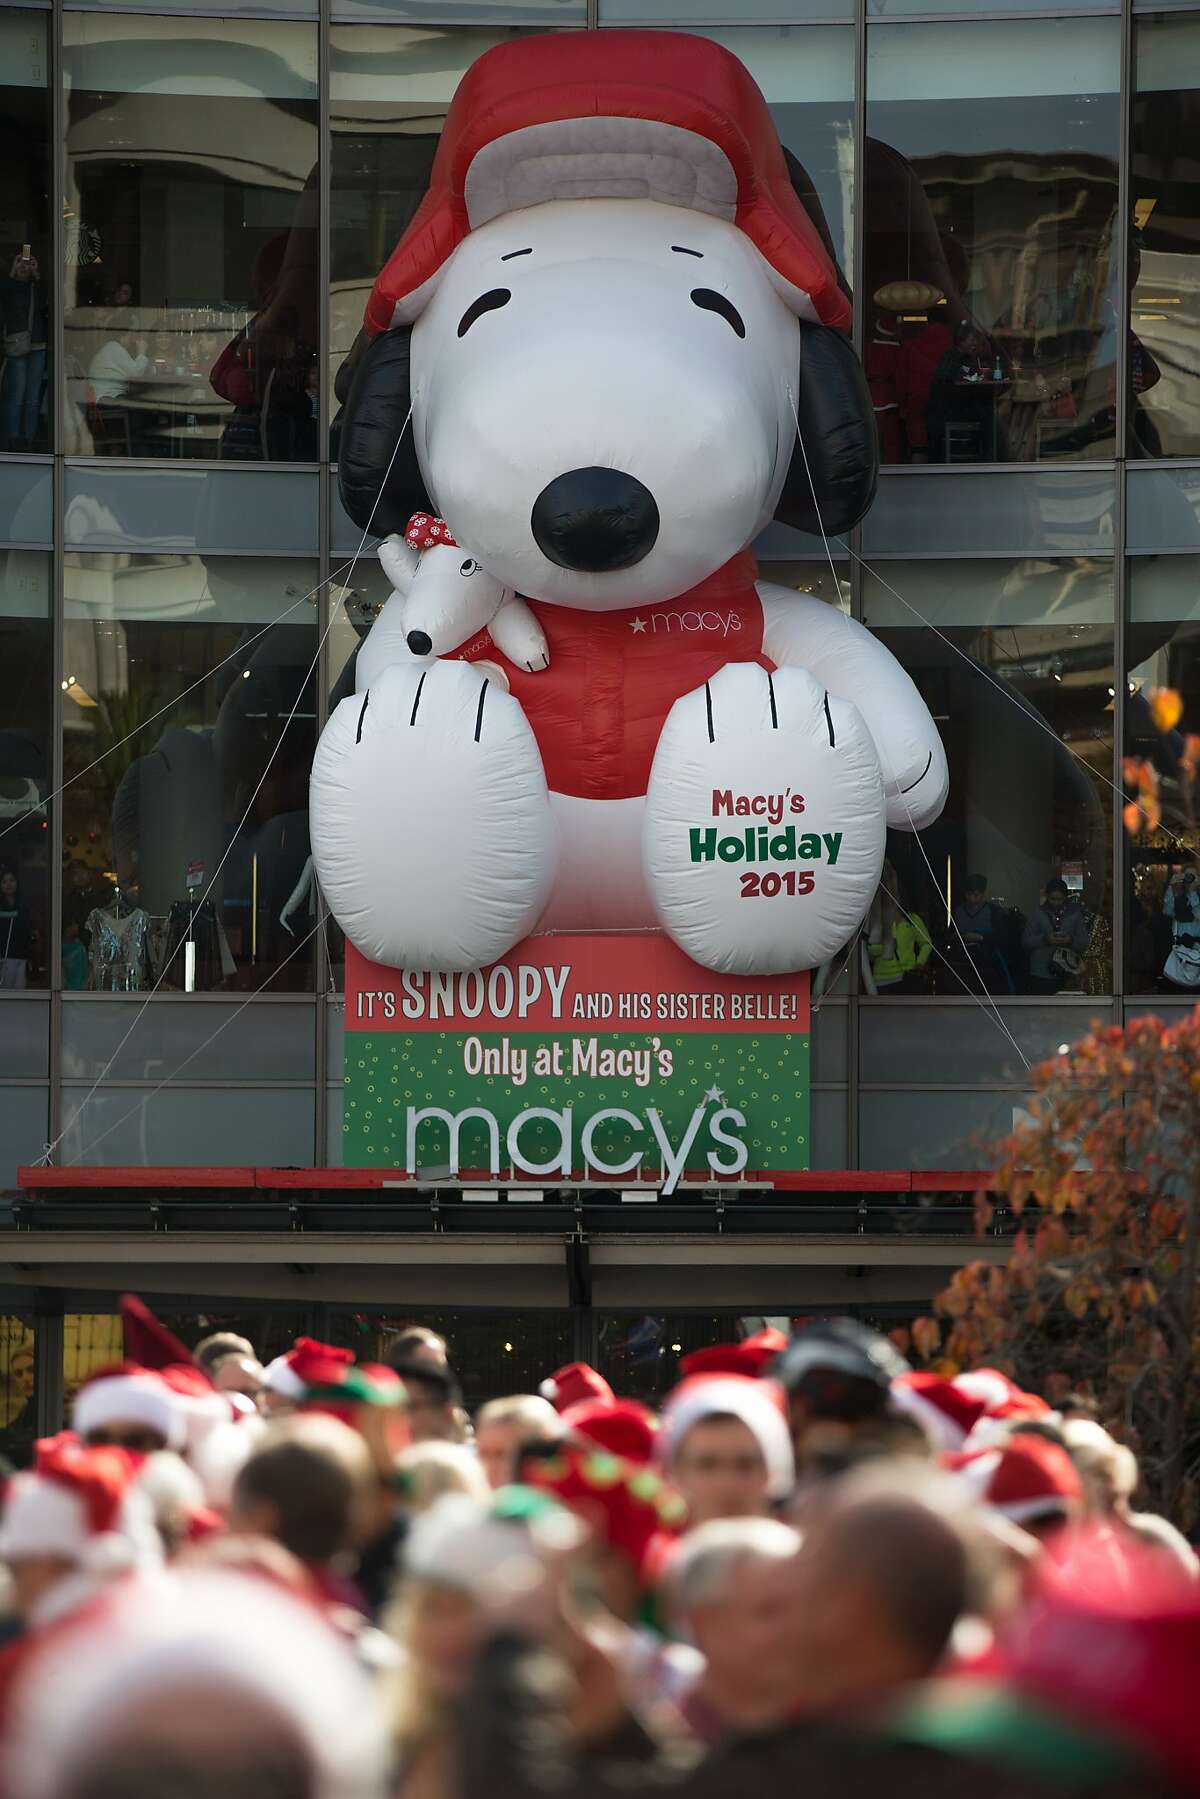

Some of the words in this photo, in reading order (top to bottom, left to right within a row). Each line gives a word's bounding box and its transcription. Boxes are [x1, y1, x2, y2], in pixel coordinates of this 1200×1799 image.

[712, 787, 806, 825] Macy's
[688, 825, 843, 865] Holiday
[739, 870, 816, 898] 2015
[356, 991, 396, 1018] IT'S
[401, 965, 571, 1019] SNOOPY
[572, 993, 614, 1019] AND
[618, 993, 652, 1019] HIS
[656, 993, 726, 1020] SISTER
[730, 994, 799, 1020] BELLE!
[463, 1036, 528, 1086] Only
[534, 1041, 564, 1076] at
[571, 1037, 674, 1087] Macy's
